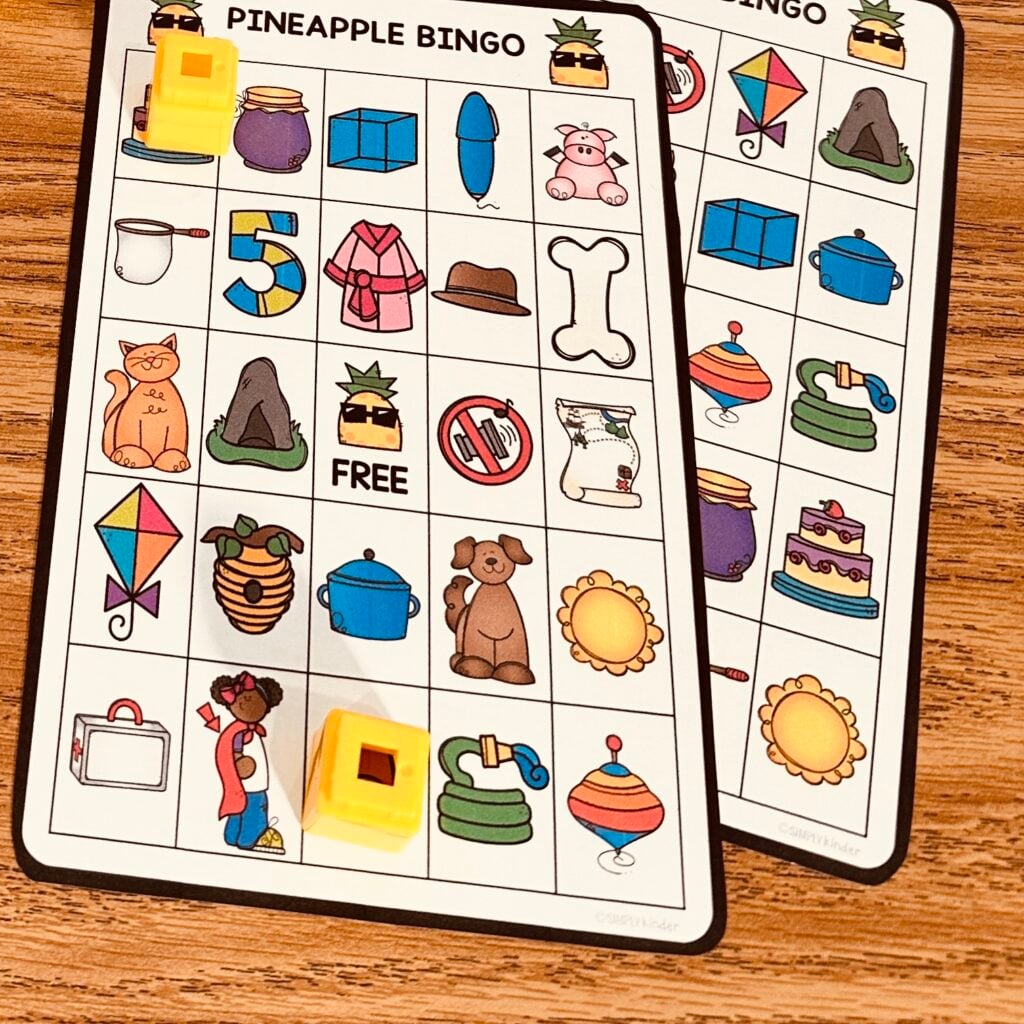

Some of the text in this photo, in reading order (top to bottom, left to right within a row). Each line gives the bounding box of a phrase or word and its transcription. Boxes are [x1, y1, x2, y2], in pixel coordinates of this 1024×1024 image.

[226, 6, 526, 60] PINEAPPLE BINGO
[330, 457, 411, 497] FREE
